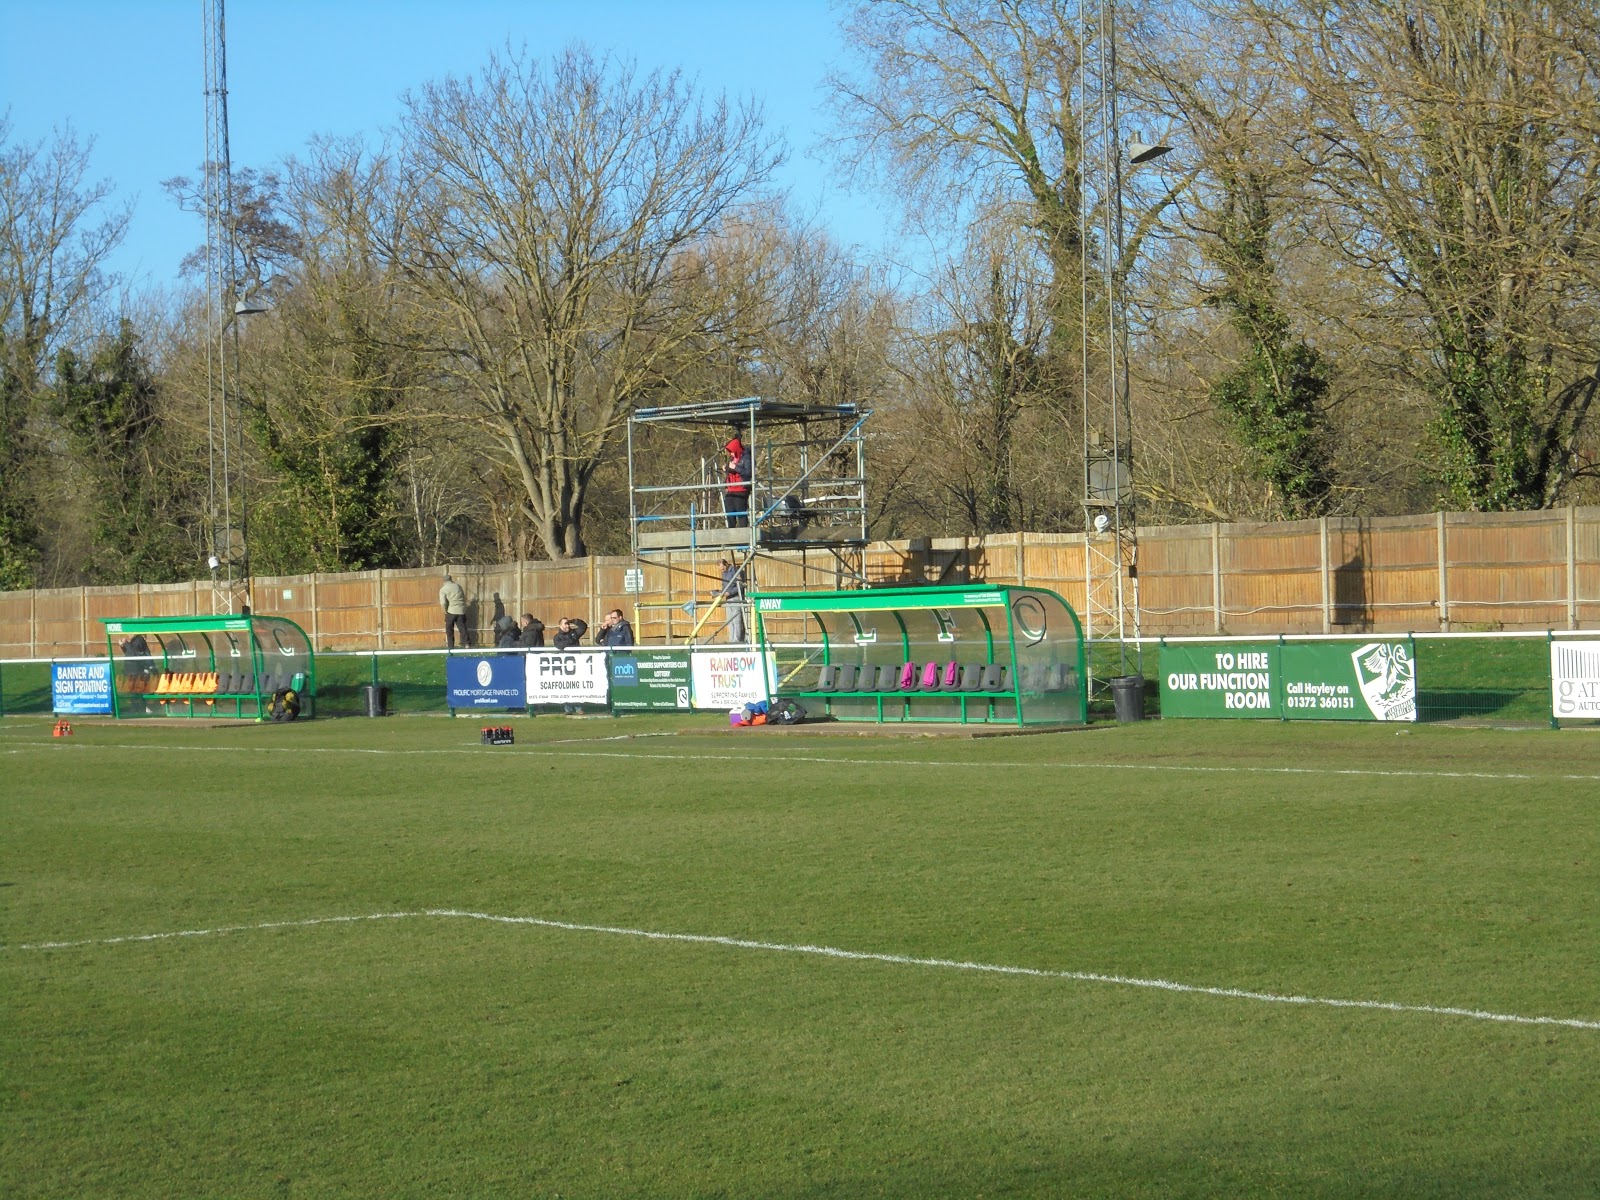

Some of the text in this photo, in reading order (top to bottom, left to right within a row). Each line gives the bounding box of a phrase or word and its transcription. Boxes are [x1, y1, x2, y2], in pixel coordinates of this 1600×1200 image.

[760, 599, 782, 610] AWAY
[107, 623, 122, 633] HOME
[539, 655, 593, 676] PRO 1
[710, 656, 756, 672] RAINBOW
[1215, 652, 1269, 670] TO HIRE
[57, 666, 105, 680] BANNER AND
[55, 680, 108, 693] SIGN PRINTING
[540, 681, 594, 690] SCAFFOLDING LTD
[710, 673, 744, 689] TRUST
[1167, 672, 1270, 690] OUR FUNCTION
[710, 690, 758, 699] SUPPORTING FAMILIES
[1287, 682, 1349, 696] Call Hayley on
[1225, 691, 1271, 709] ROOM
[1287, 697, 1354, 709] 01372 360151
